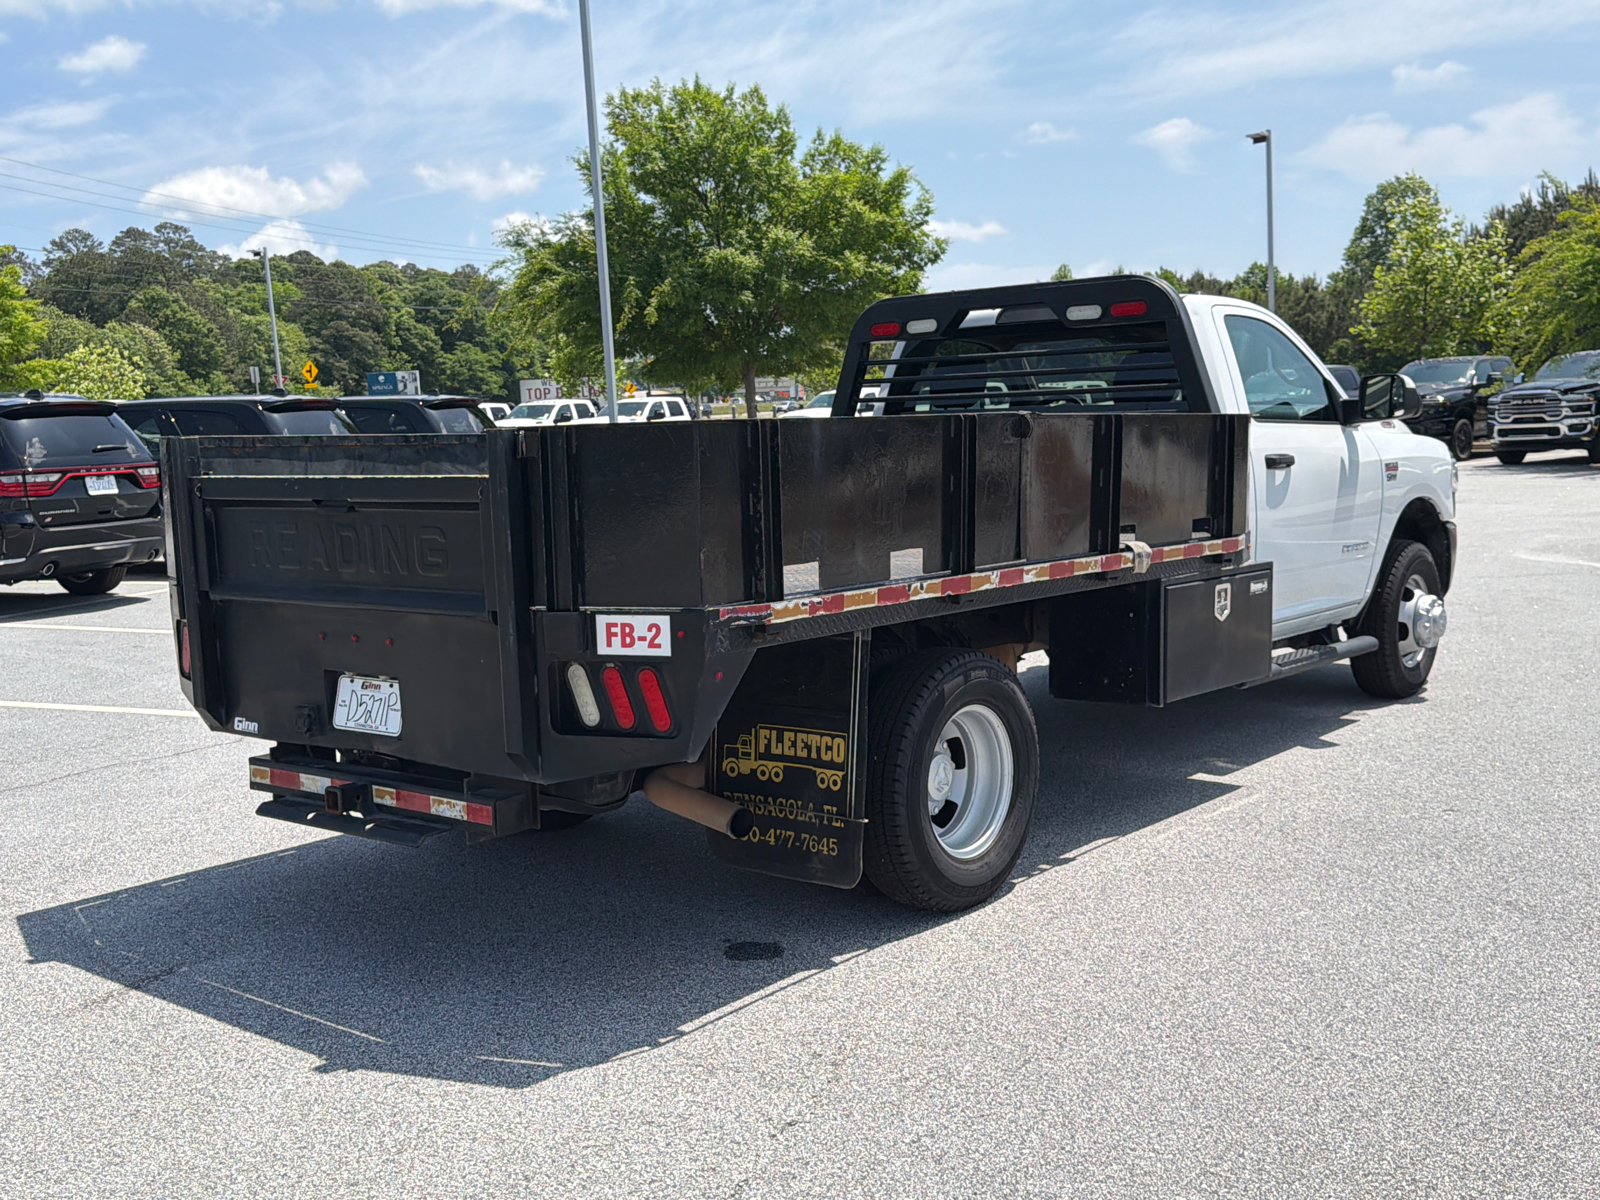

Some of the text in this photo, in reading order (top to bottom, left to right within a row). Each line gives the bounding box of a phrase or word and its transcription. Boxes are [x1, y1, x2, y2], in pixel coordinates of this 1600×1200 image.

[526, 387, 551, 400] TOP
[250, 521, 449, 577] READING
[605, 622, 662, 649] FB-2
[361, 681, 382, 691] Ginn
[234, 716, 259, 731] Ginn
[759, 729, 845, 763] FLEETCO
[730, 826, 839, 856] 0-477-7645
